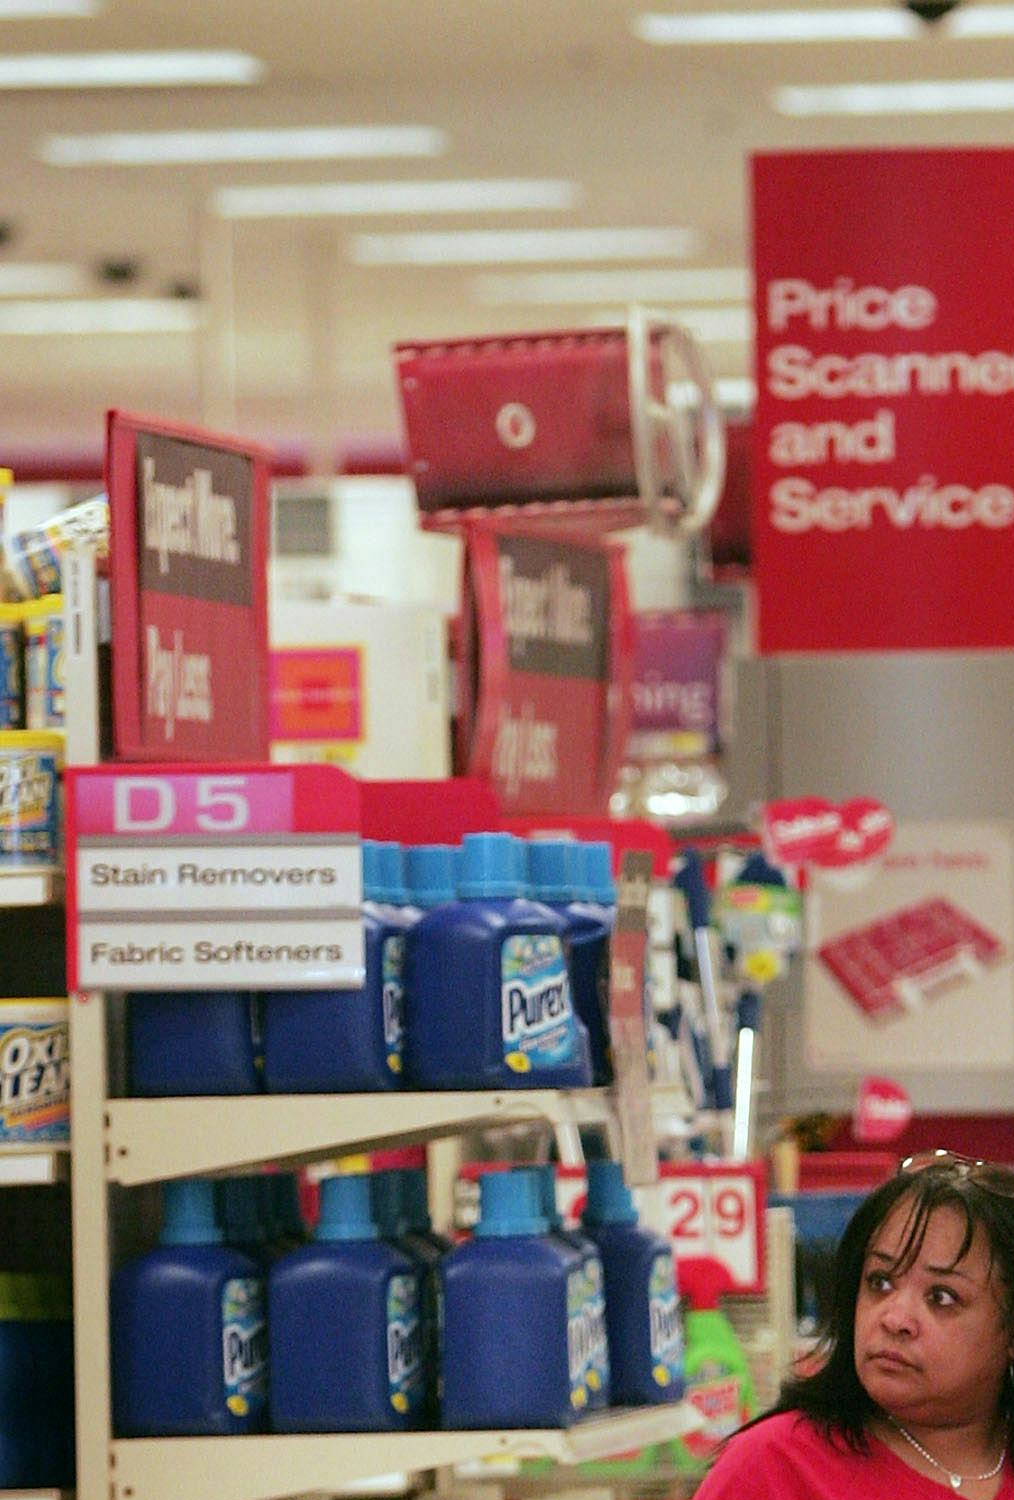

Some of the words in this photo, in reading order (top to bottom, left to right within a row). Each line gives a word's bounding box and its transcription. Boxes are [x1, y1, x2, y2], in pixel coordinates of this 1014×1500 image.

[767, 276, 938, 333] Price
[768, 408, 896, 468] and
[113, 776, 174, 832] D
[195, 776, 248, 831] 5
[90, 863, 167, 886] Stain
[177, 863, 337, 886] Removers
[90, 942, 184, 964] Fabric
[194, 941, 343, 963] Softeners
[508, 983, 565, 1036] Purex
[669, 1188, 746, 1239] 29
